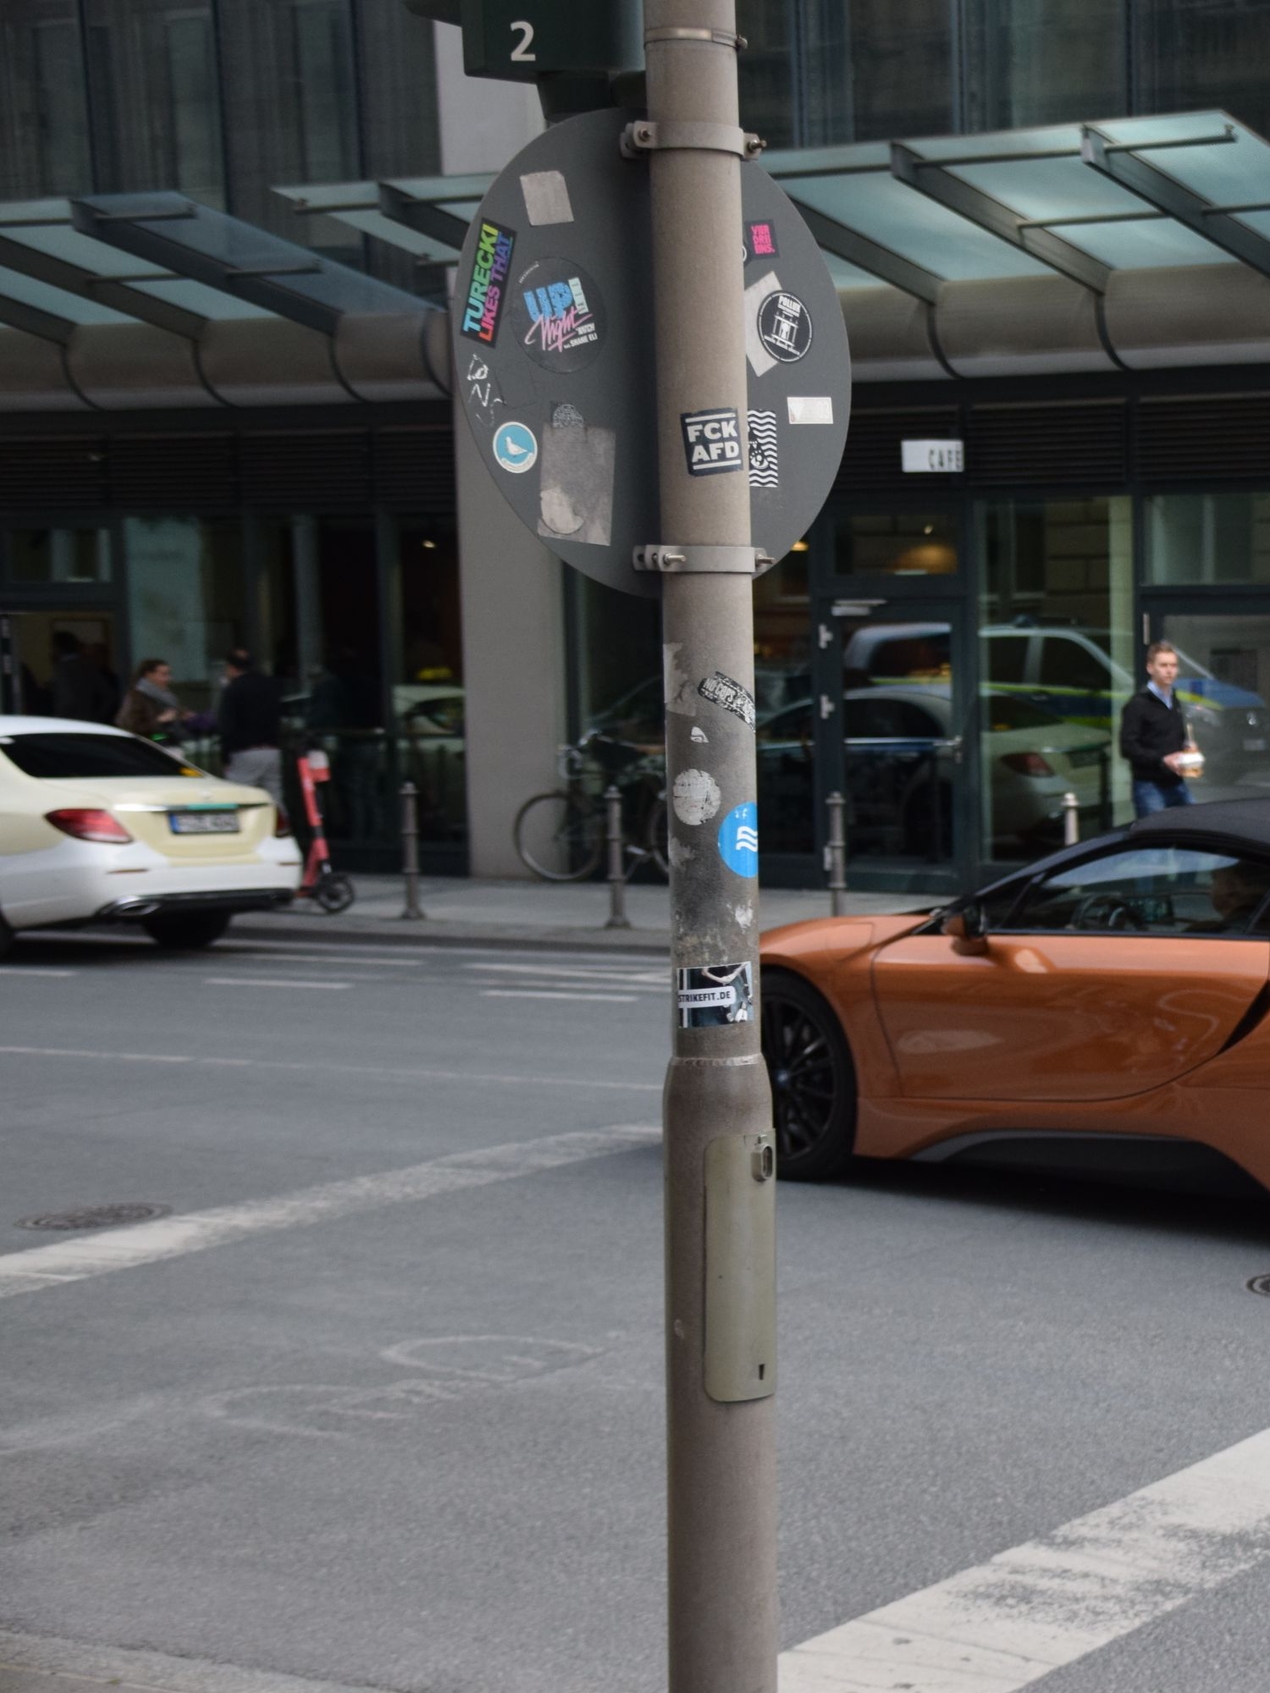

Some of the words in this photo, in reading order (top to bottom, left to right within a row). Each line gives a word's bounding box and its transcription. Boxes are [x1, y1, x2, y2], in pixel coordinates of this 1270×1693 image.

[510, 20, 536, 61] 2
[463, 223, 499, 332] TURECKI
[478, 285, 501, 342] LIKES
[490, 231, 510, 281] THAT
[523, 281, 574, 325] UP
[686, 420, 738, 443] FCK
[691, 441, 740, 463] AFD
